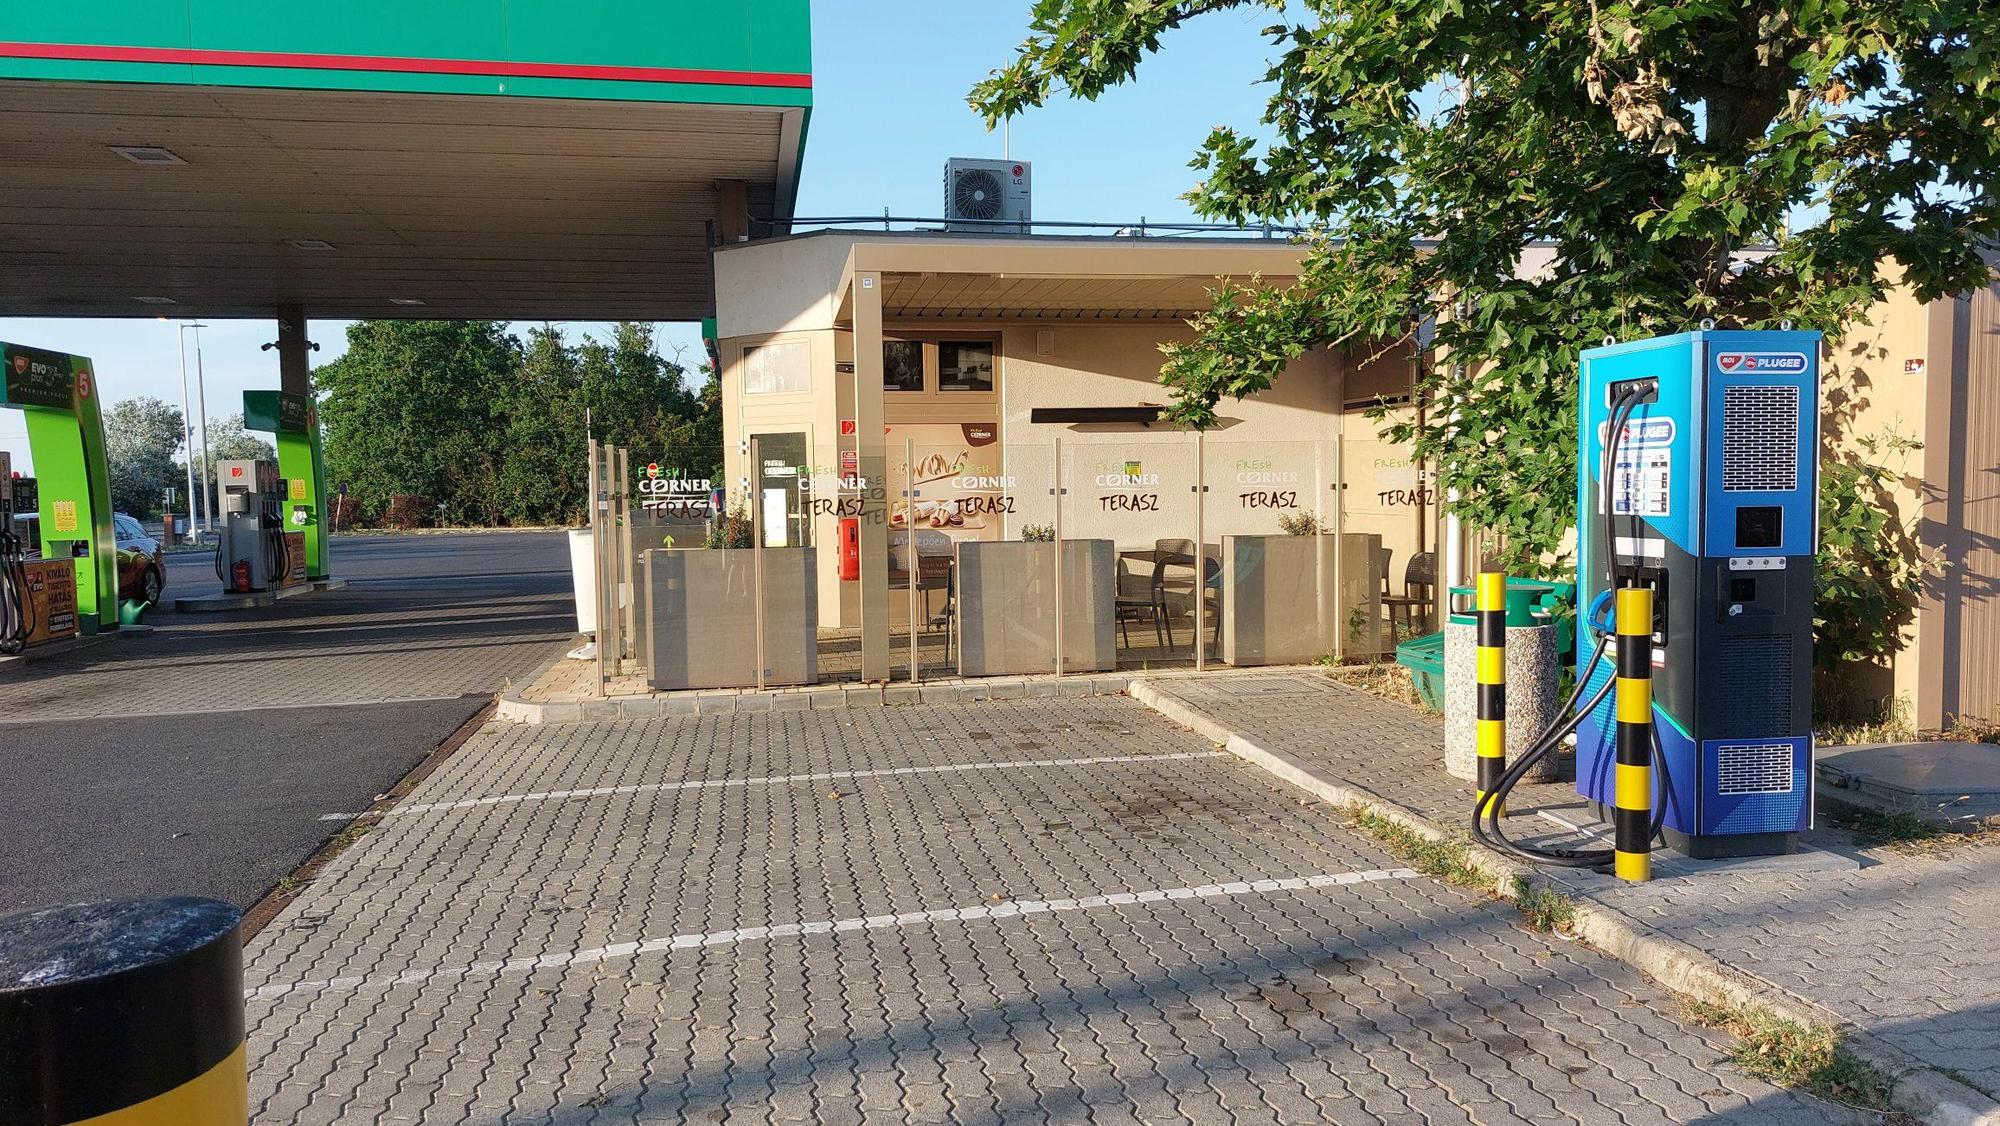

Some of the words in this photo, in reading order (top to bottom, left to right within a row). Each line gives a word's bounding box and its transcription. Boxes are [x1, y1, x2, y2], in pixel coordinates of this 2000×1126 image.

[31, 362, 47, 375] EVO
[1758, 358, 1802, 368] PLUGEE
[79, 373, 90, 399] 5
[637, 466, 680, 478] FESH
[1236, 459, 1272, 470] FRESH
[953, 496, 1017, 515] TERASZ
[1099, 494, 1160, 512] TERASZ
[1239, 490, 1299, 509] TERASZ
[1378, 488, 1435, 507] TERASZ
[643, 501, 713, 520] TERASZ
[800, 498, 867, 518] TERASZ
